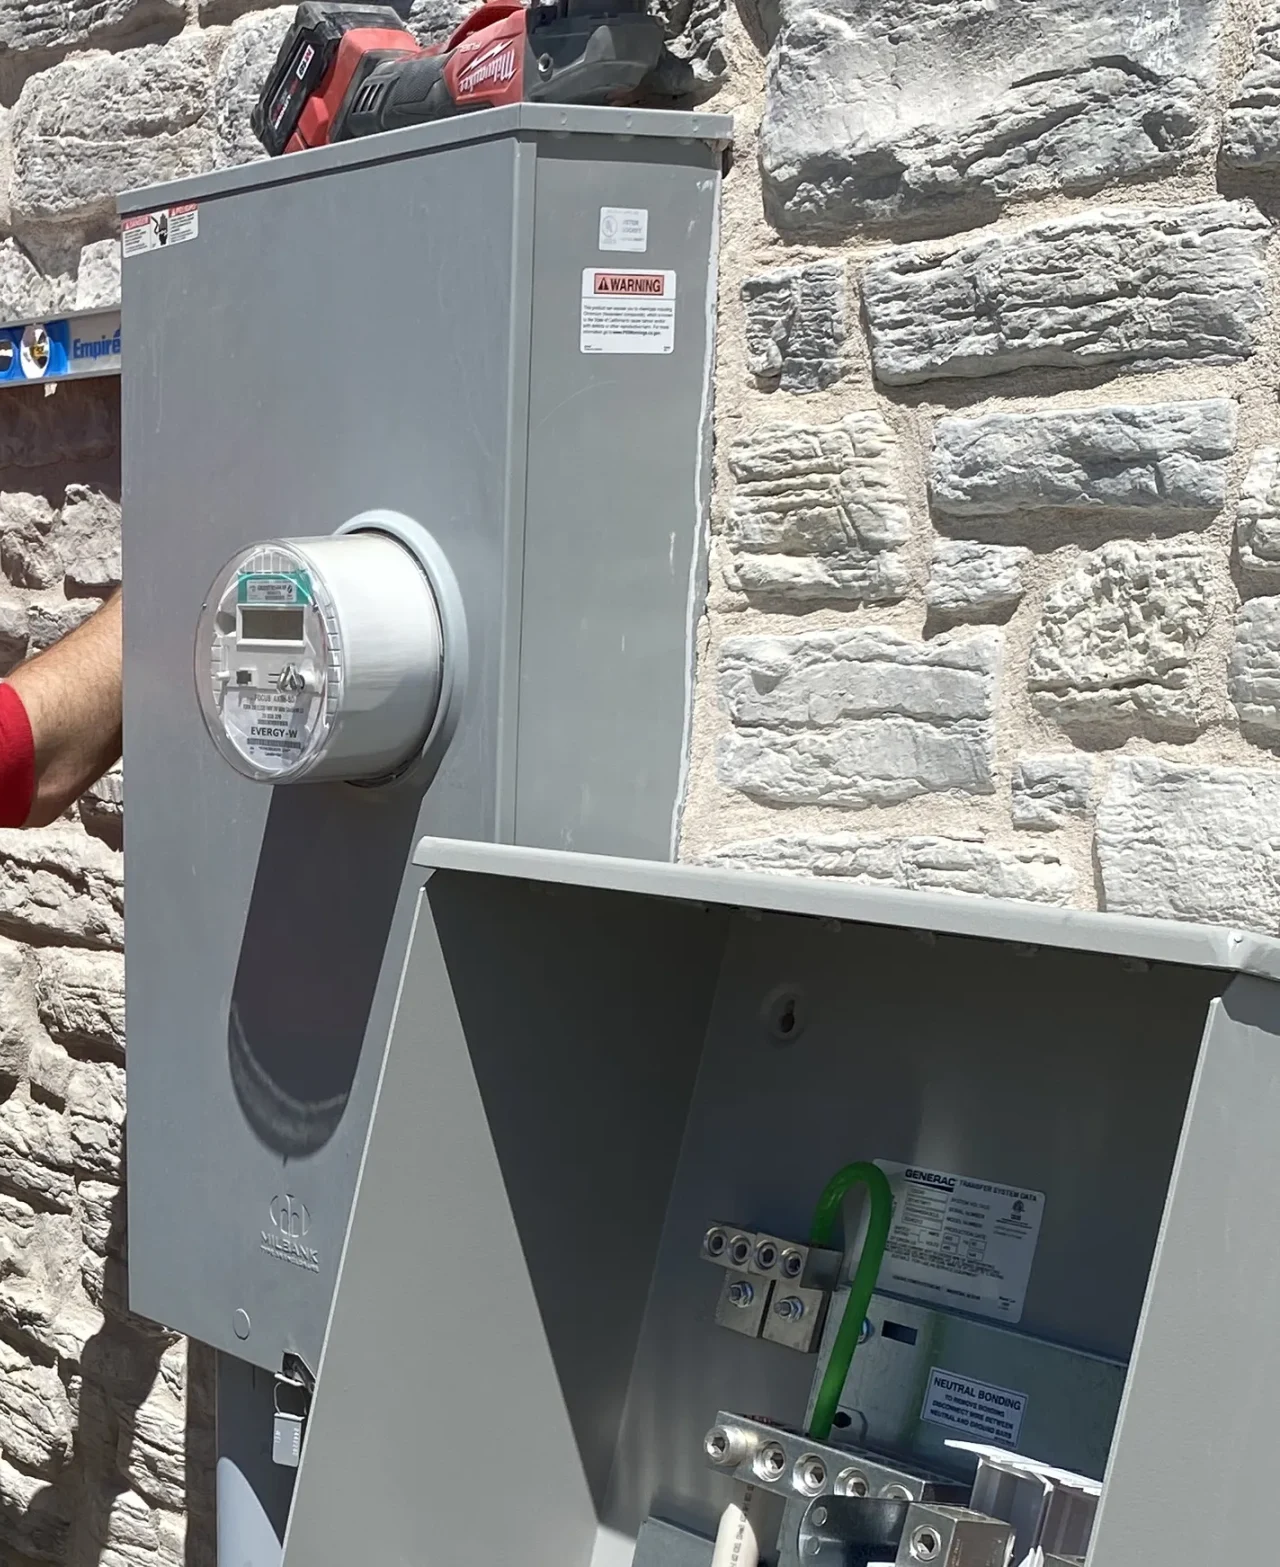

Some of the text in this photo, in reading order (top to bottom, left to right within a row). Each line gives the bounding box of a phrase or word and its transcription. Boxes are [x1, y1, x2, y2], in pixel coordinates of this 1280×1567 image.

[459, 49, 517, 92] Milwaukee
[610, 278, 661, 293] WARNING
[73, 334, 121, 360] Empire
[251, 726, 298, 738] EVERGY-W
[905, 1168, 1037, 1202] GENERAC TRANSFER SYSTEM DATA
[260, 1230, 319, 1265] MILBANK
[934, 1377, 1022, 1411] NEUTRAL BONDING
